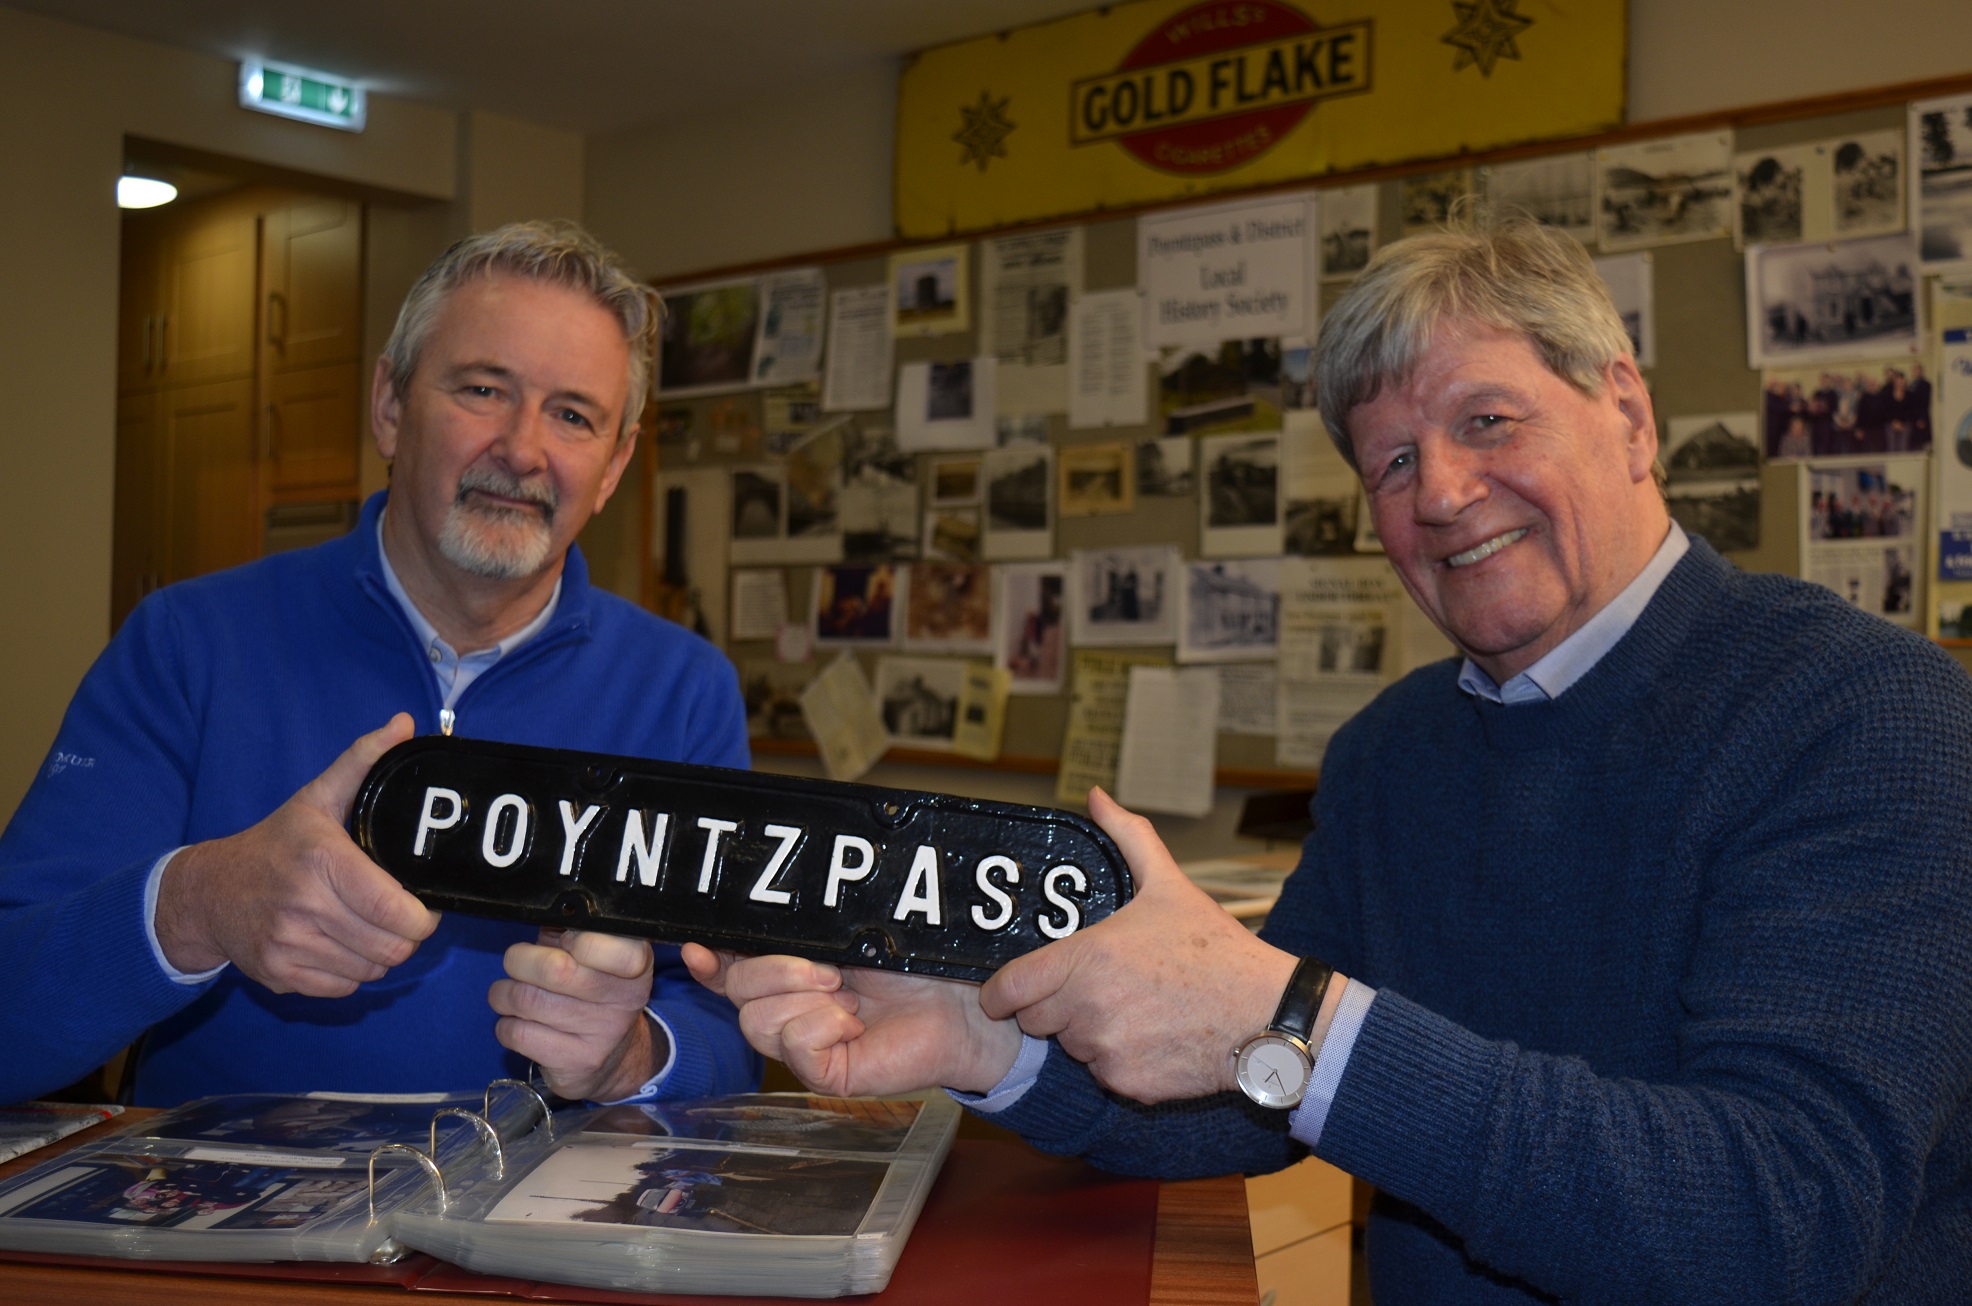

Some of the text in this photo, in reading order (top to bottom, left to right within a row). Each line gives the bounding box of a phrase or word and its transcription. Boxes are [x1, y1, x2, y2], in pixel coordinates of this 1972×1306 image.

[1084, 33, 1356, 132] GOLD FLAKE
[1230, 224, 1242, 246] &
[1246, 217, 1306, 243] District
[1200, 259, 1247, 290] Local
[1160, 290, 1289, 328] History Society
[413, 787, 1088, 939] POYNTZPASS
